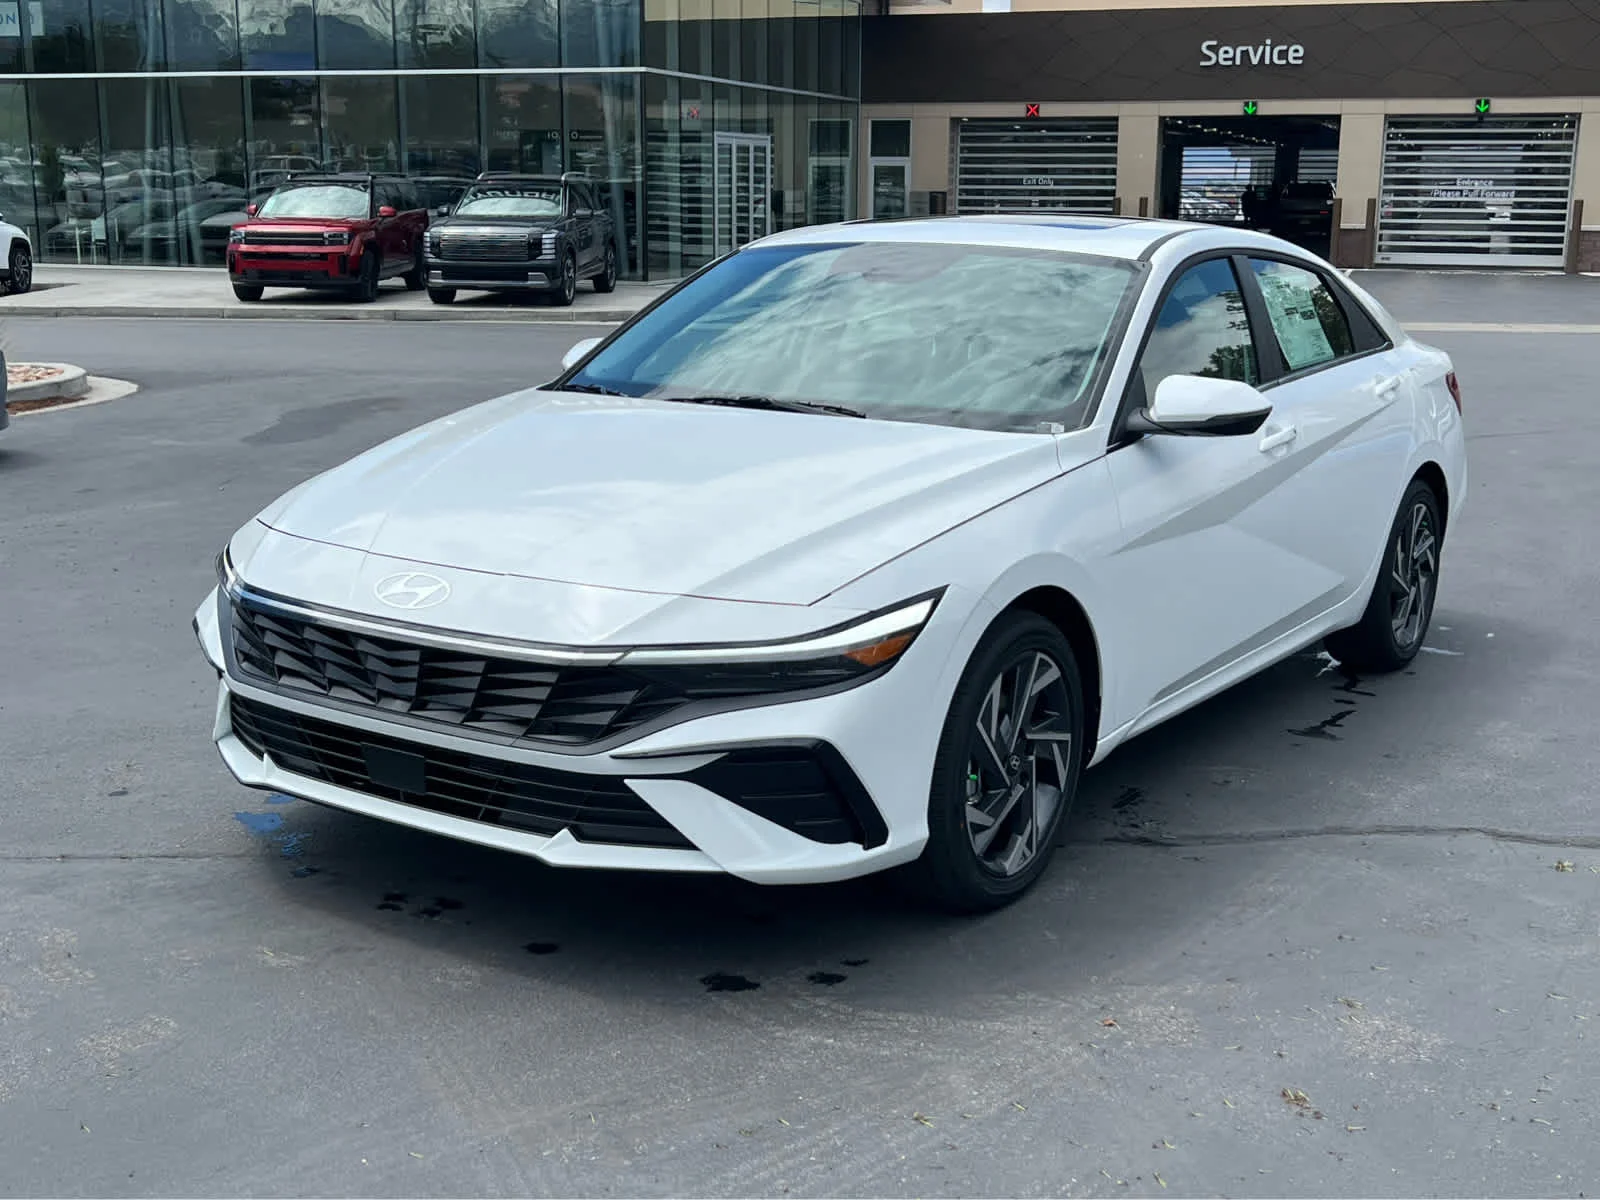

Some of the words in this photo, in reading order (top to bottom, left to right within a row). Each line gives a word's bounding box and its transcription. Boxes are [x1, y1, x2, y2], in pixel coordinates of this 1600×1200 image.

[1200, 39, 1304, 66] Service
[1022, 176, 1037, 185] Exit
[1038, 176, 1054, 188] Only
[1456, 177, 1494, 187] Entrance
[1433, 189, 1460, 199] Please
[1462, 189, 1479, 199] Pull
[1481, 189, 1516, 199] Forward
